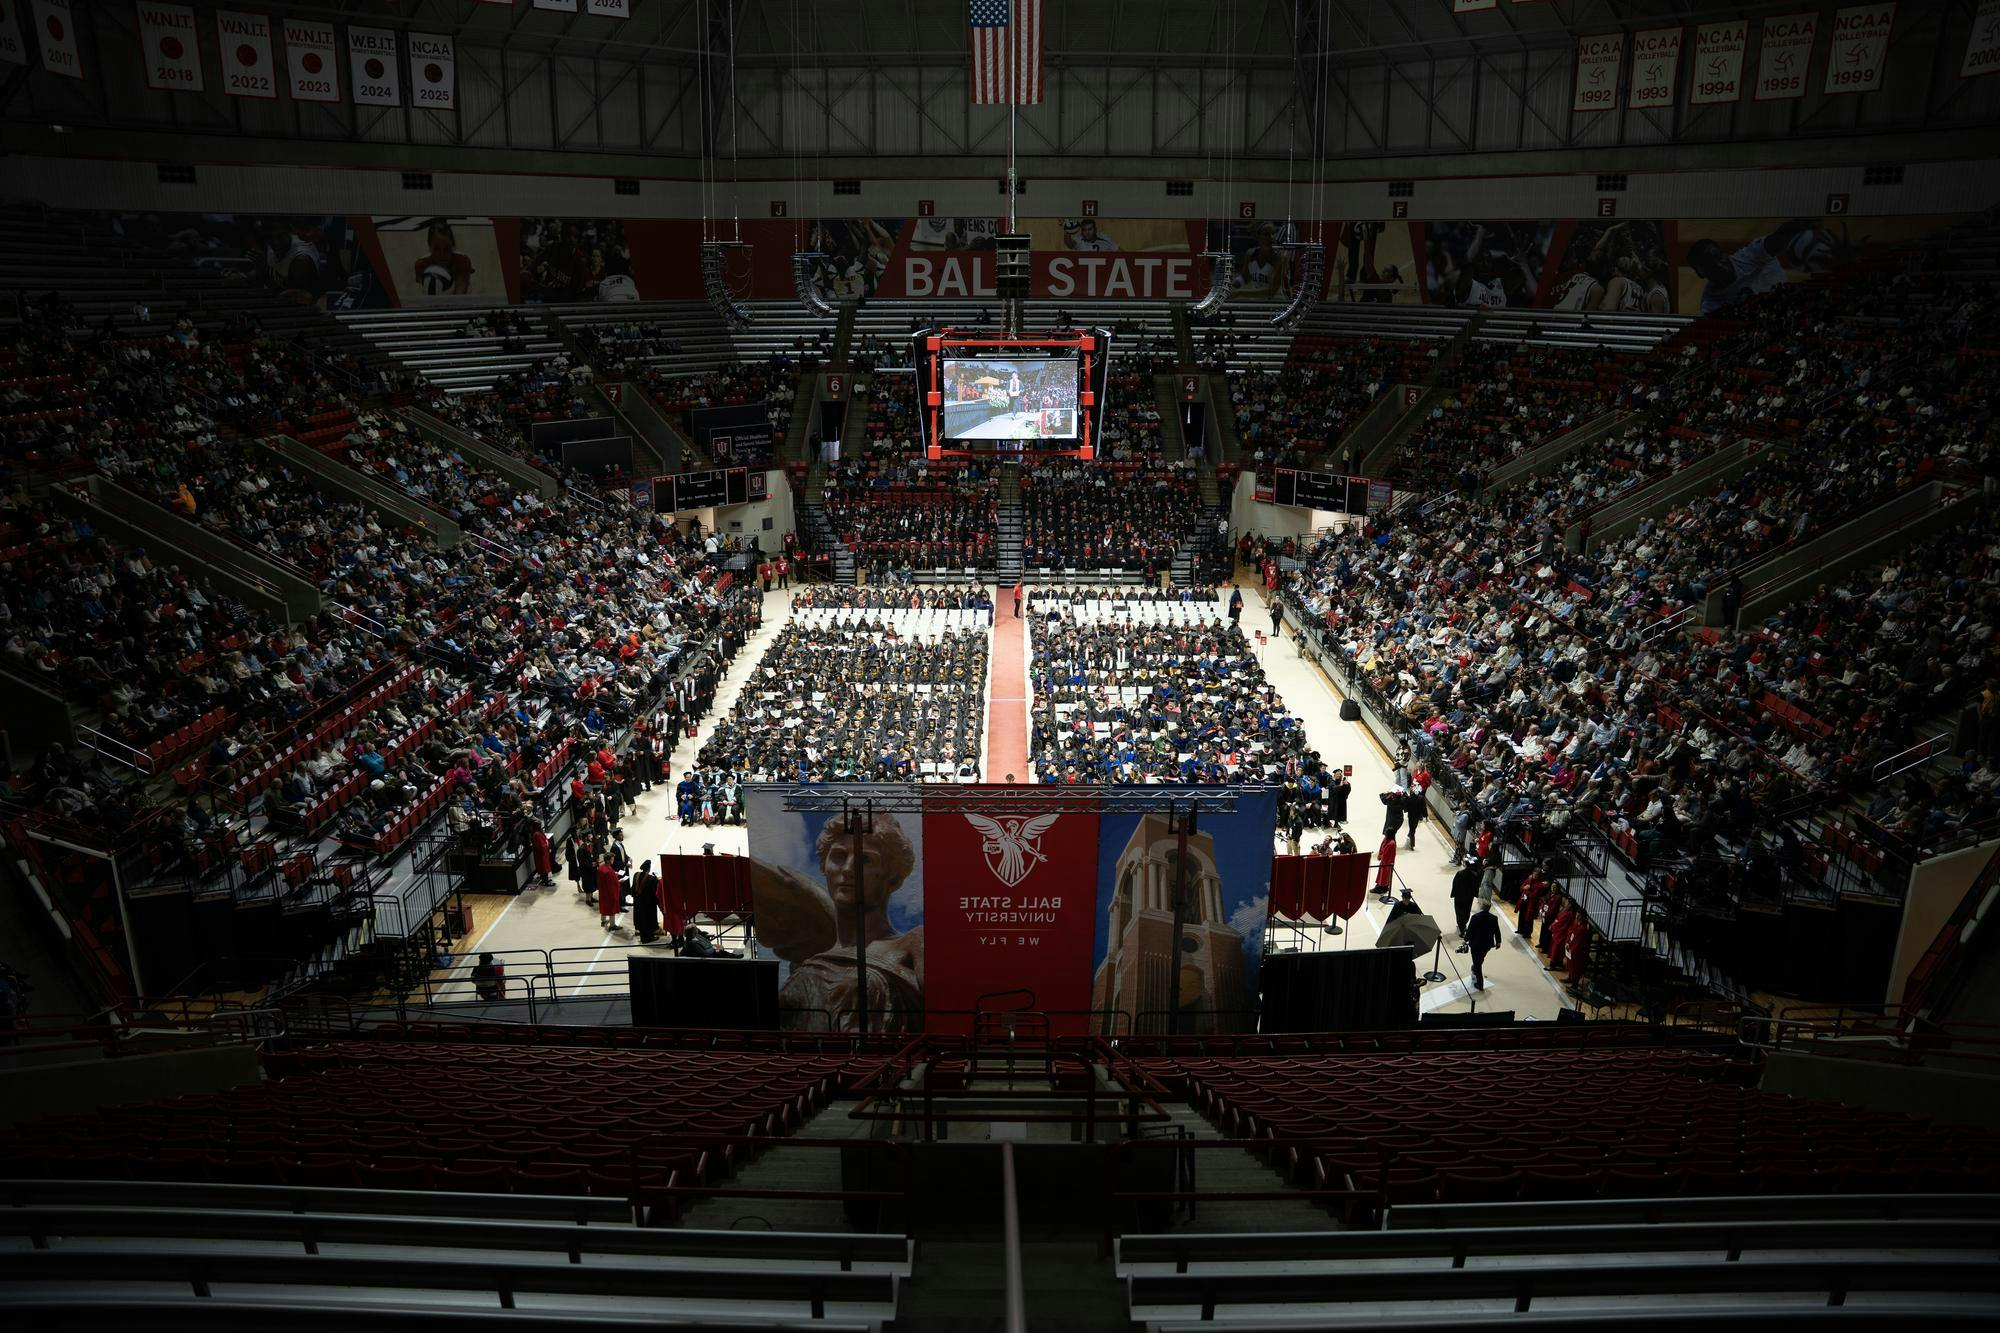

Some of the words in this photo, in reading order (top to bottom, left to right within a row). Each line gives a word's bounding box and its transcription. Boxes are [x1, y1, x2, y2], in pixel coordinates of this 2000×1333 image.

[143, 11, 193, 28] W.N.I.T.
[1836, 12, 1891, 30] NCAA
[220, 19, 268, 37] W.N.I.T.
[1764, 21, 1813, 38] NCAA
[287, 28, 333, 44] W.N.I.T.
[351, 34, 395, 50] W.B.I.T.
[1697, 29, 1745, 44] NCAA
[412, 42, 450, 55] NCAA
[1580, 41, 1621, 56] NCAA
[1635, 36, 1679, 52] NCAA
[48, 48, 73, 65] 2017
[158, 67, 193, 81] 2018
[1833, 69, 1875, 85] 1999
[231, 75, 270, 89] 2022
[298, 79, 331, 93] 2023
[1698, 81, 1735, 95] 1994
[1763, 76, 1801, 91] 1995
[361, 85, 393, 97] 2024
[420, 89, 449, 101] 2025
[1582, 89, 1611, 103] 1992
[1636, 86, 1669, 100] 1993
[905, 258, 998, 297] BAL
[1047, 256, 1193, 298] STATE
[831, 380, 841, 392] 6
[1185, 380, 1196, 392] 4
